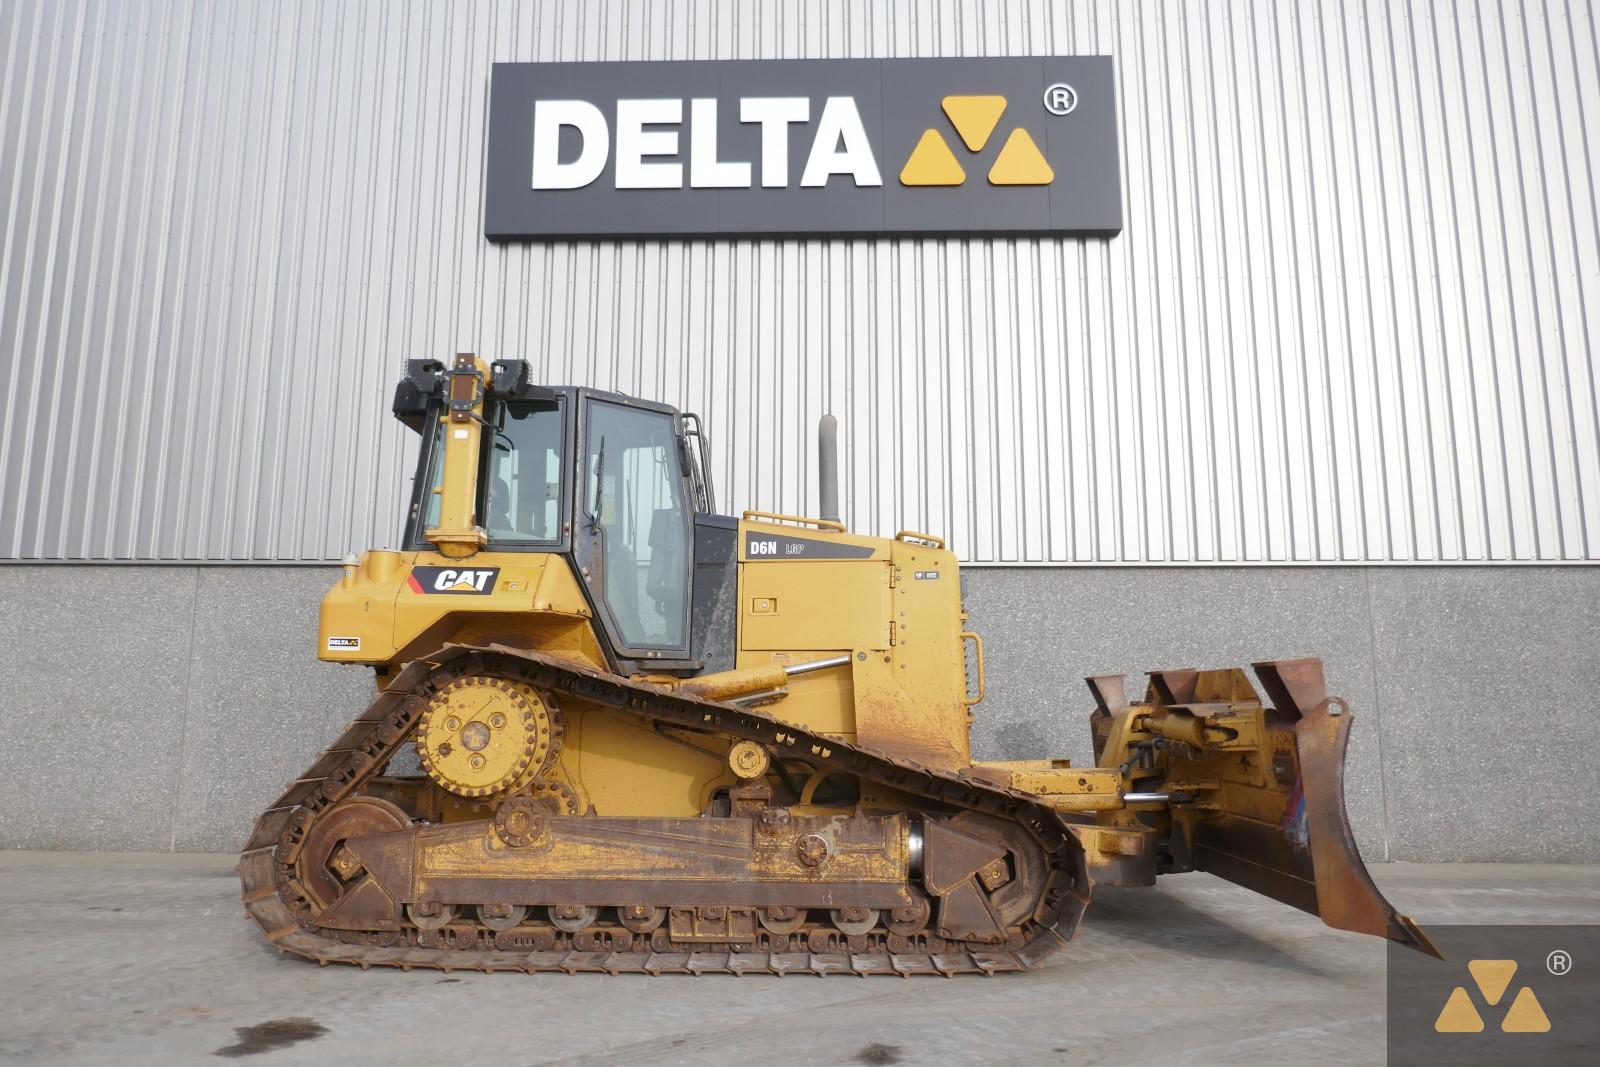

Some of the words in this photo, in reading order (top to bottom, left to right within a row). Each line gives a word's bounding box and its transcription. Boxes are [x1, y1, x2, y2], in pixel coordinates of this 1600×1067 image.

[532, 96, 883, 190] DELTA
[750, 541, 777, 555] D6N
[785, 543, 805, 555] LGP
[434, 569, 494, 592] CAT
[329, 639, 349, 647] DELTA
